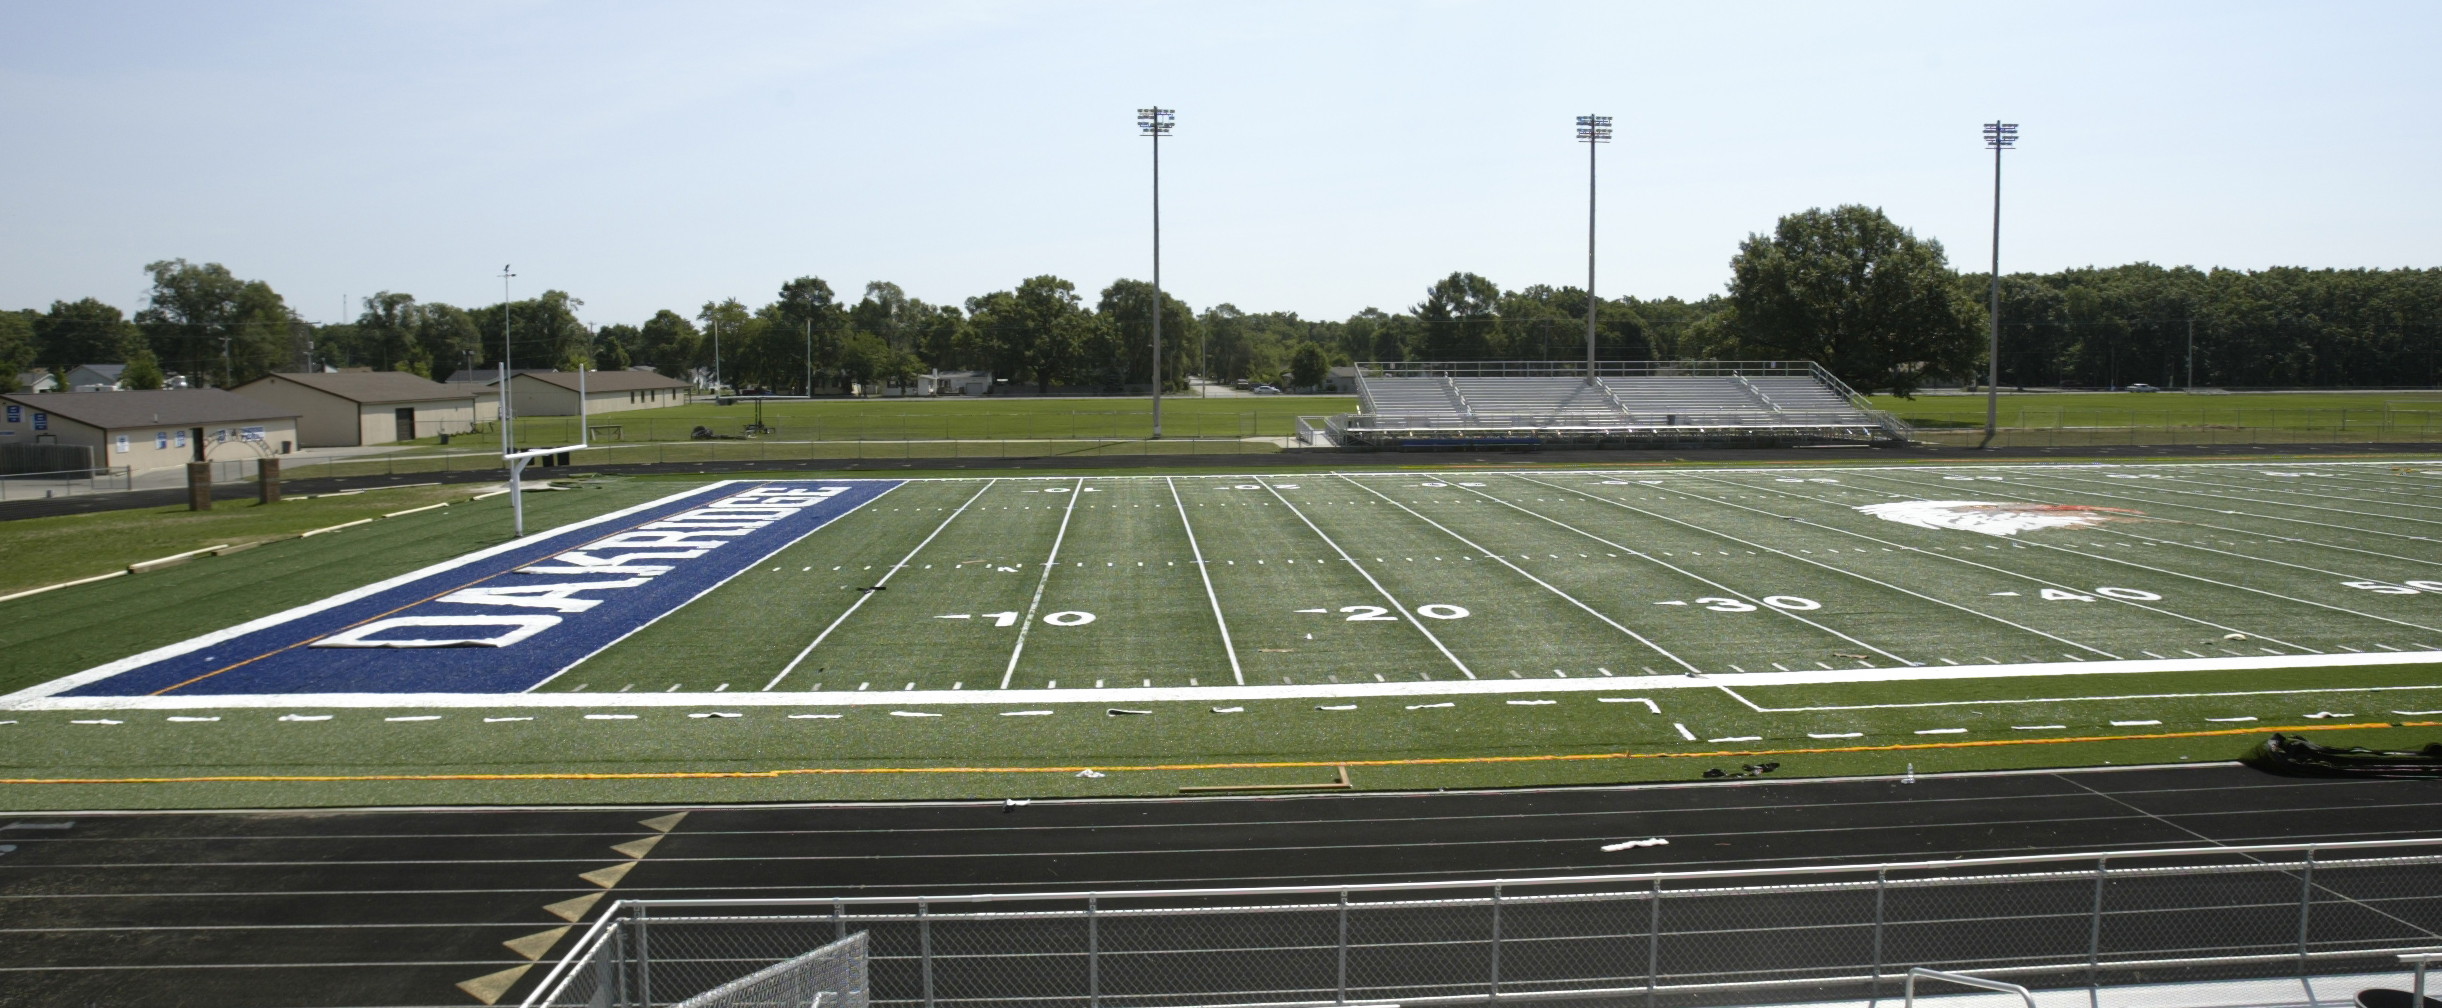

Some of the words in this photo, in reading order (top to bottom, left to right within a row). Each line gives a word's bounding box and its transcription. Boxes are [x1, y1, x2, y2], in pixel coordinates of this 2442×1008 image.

[309, 486, 852, 648] OAKRIDGE
[2041, 587, 2162, 602] 40
[1696, 595, 1821, 612] 30
[982, 611, 1096, 627] 10
[1340, 605, 1470, 621] 20
